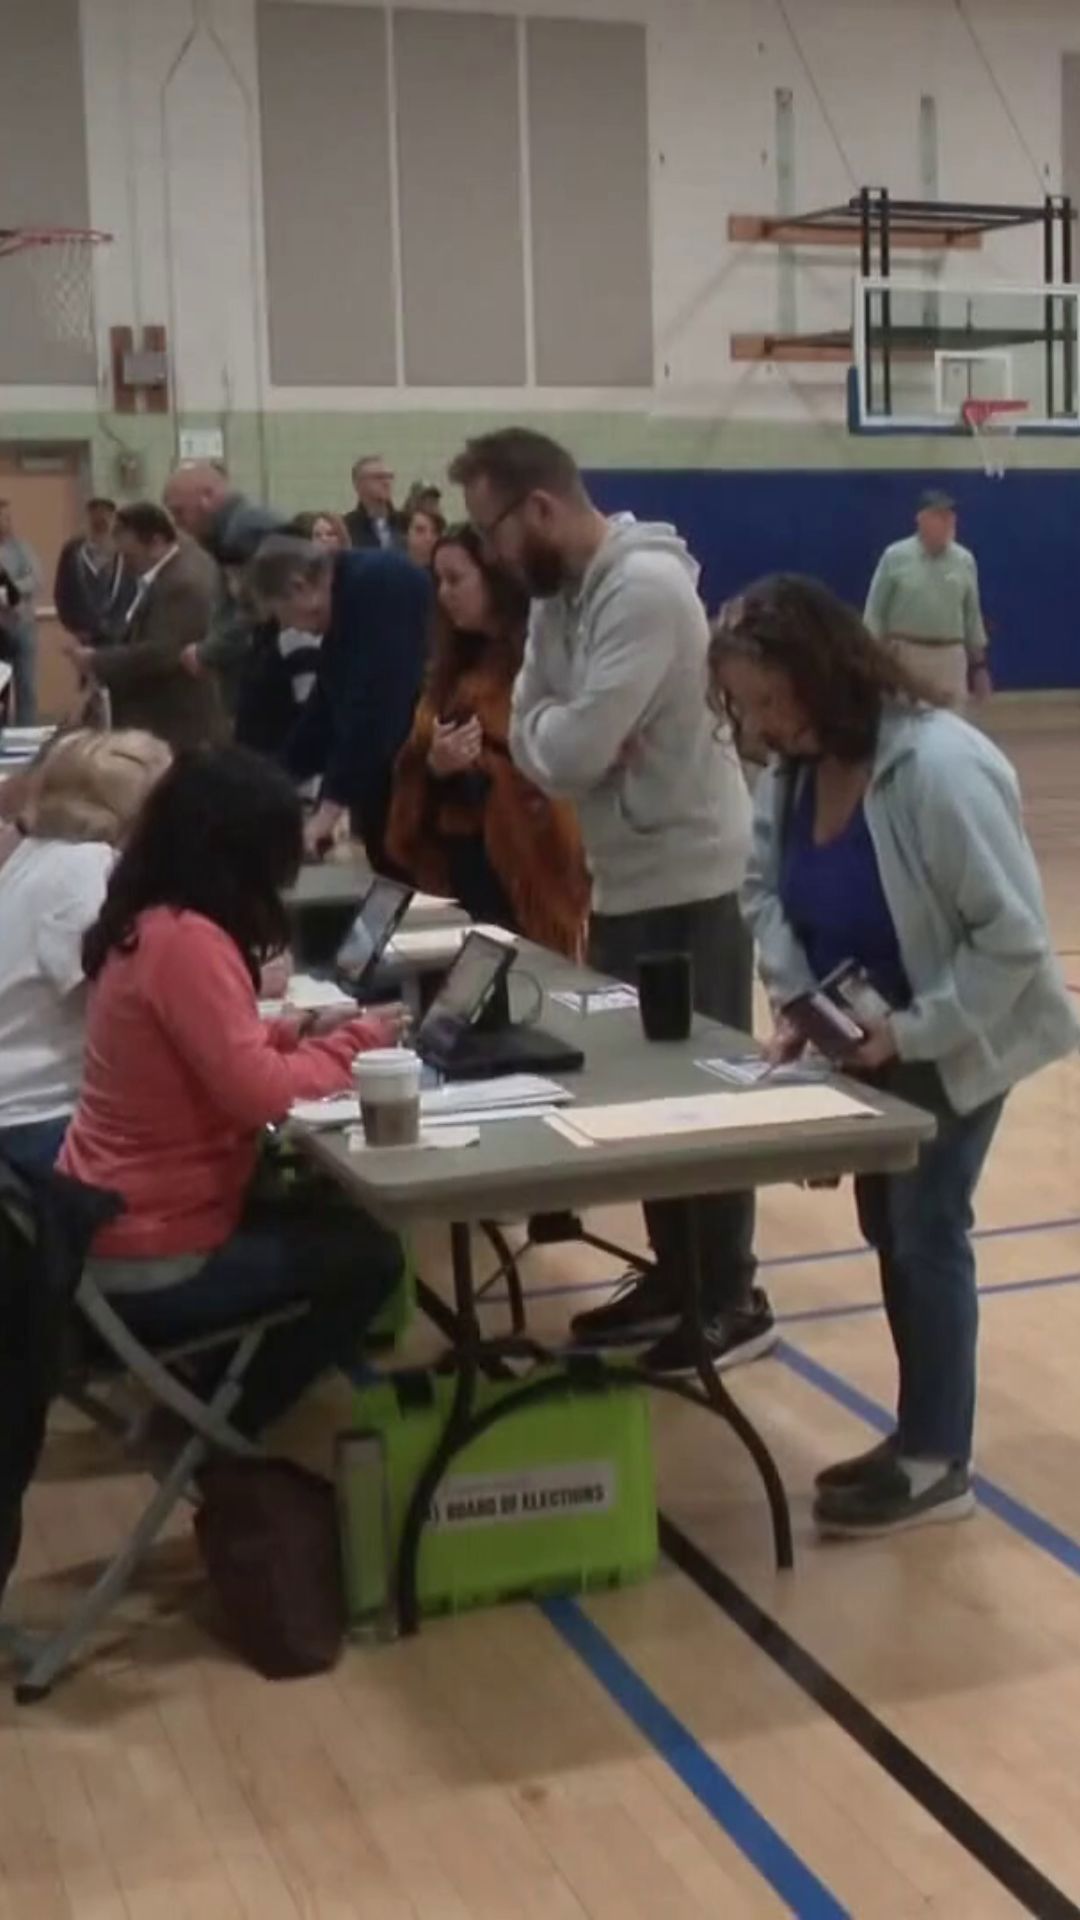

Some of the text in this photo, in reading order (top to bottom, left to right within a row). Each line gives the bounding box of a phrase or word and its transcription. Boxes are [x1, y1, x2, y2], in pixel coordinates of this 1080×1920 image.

[446, 1496, 497, 1521] BOARD
[501, 1493, 517, 1514] OF
[522, 1484, 605, 1512] ELECTIONS
